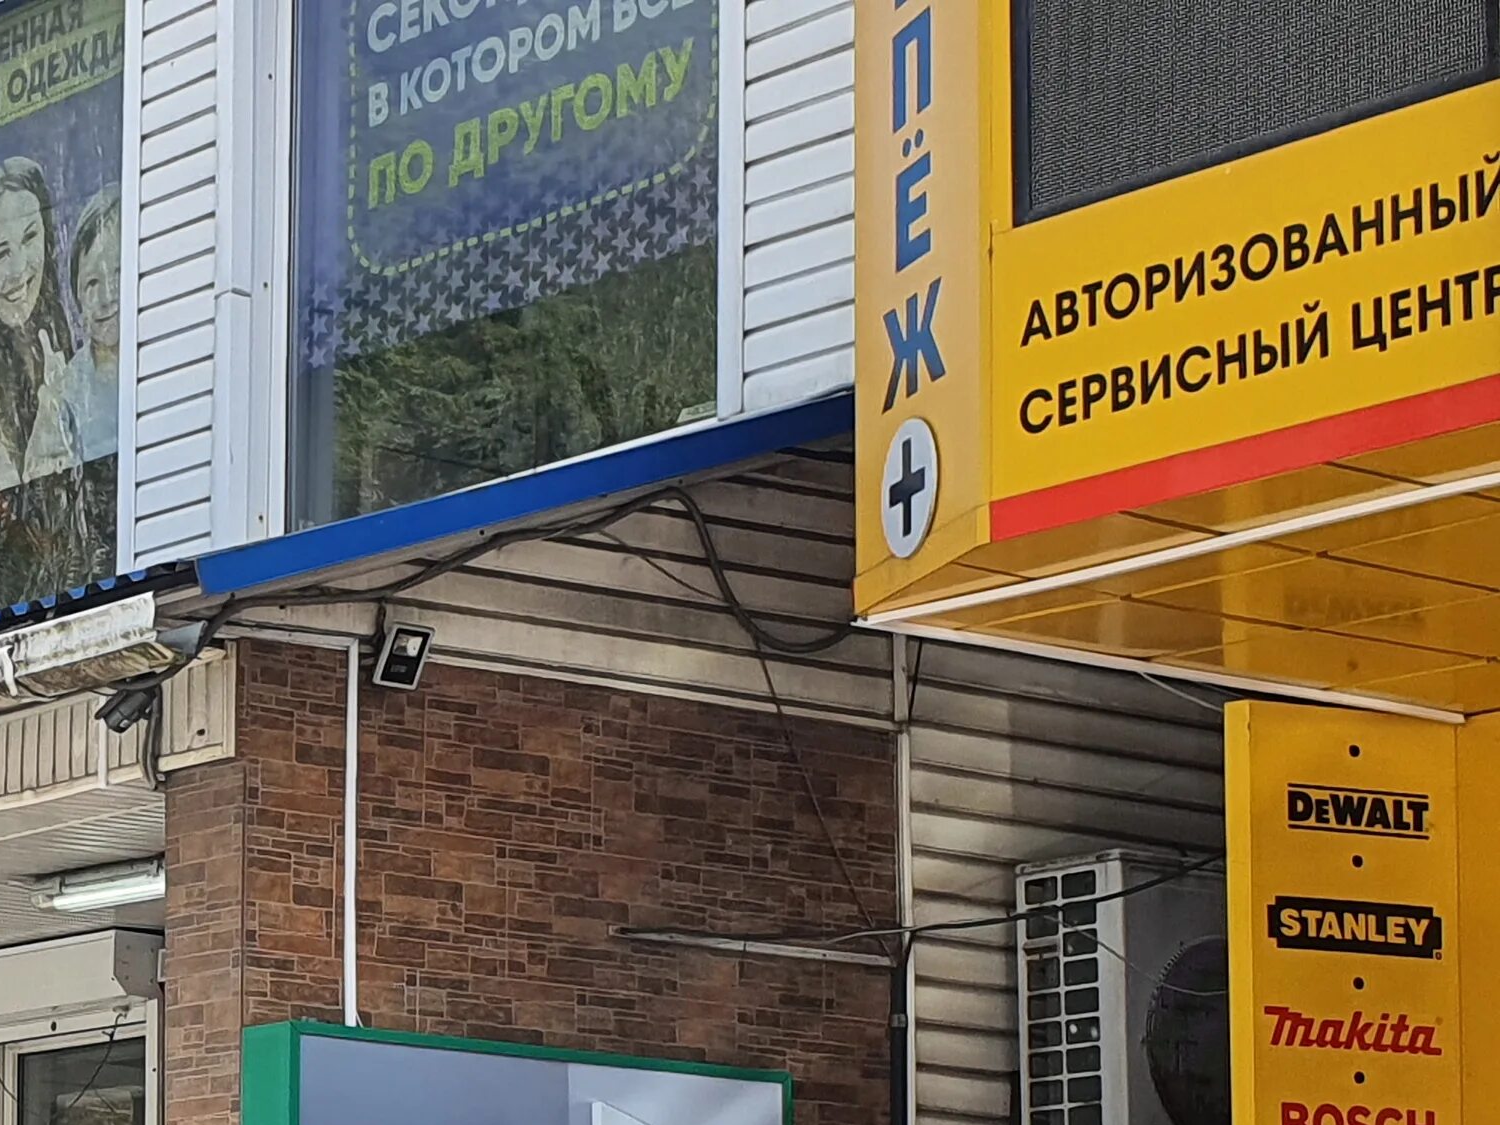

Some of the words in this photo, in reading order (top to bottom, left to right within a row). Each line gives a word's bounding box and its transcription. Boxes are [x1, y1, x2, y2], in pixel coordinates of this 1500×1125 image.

[367, 139, 434, 210] ПО
[448, 36, 694, 188] ДРУГОМУ
[400, 4, 600, 116] КОТОРОМ
[882, 0, 946, 414] ПЁЖ
[1020, 150, 1500, 347] АВТОРИЗОВАННЫЙ
[1020, 300, 1329, 434] СЕРВИСНЫЙ
[1279, 907, 1430, 946] STANLEY
